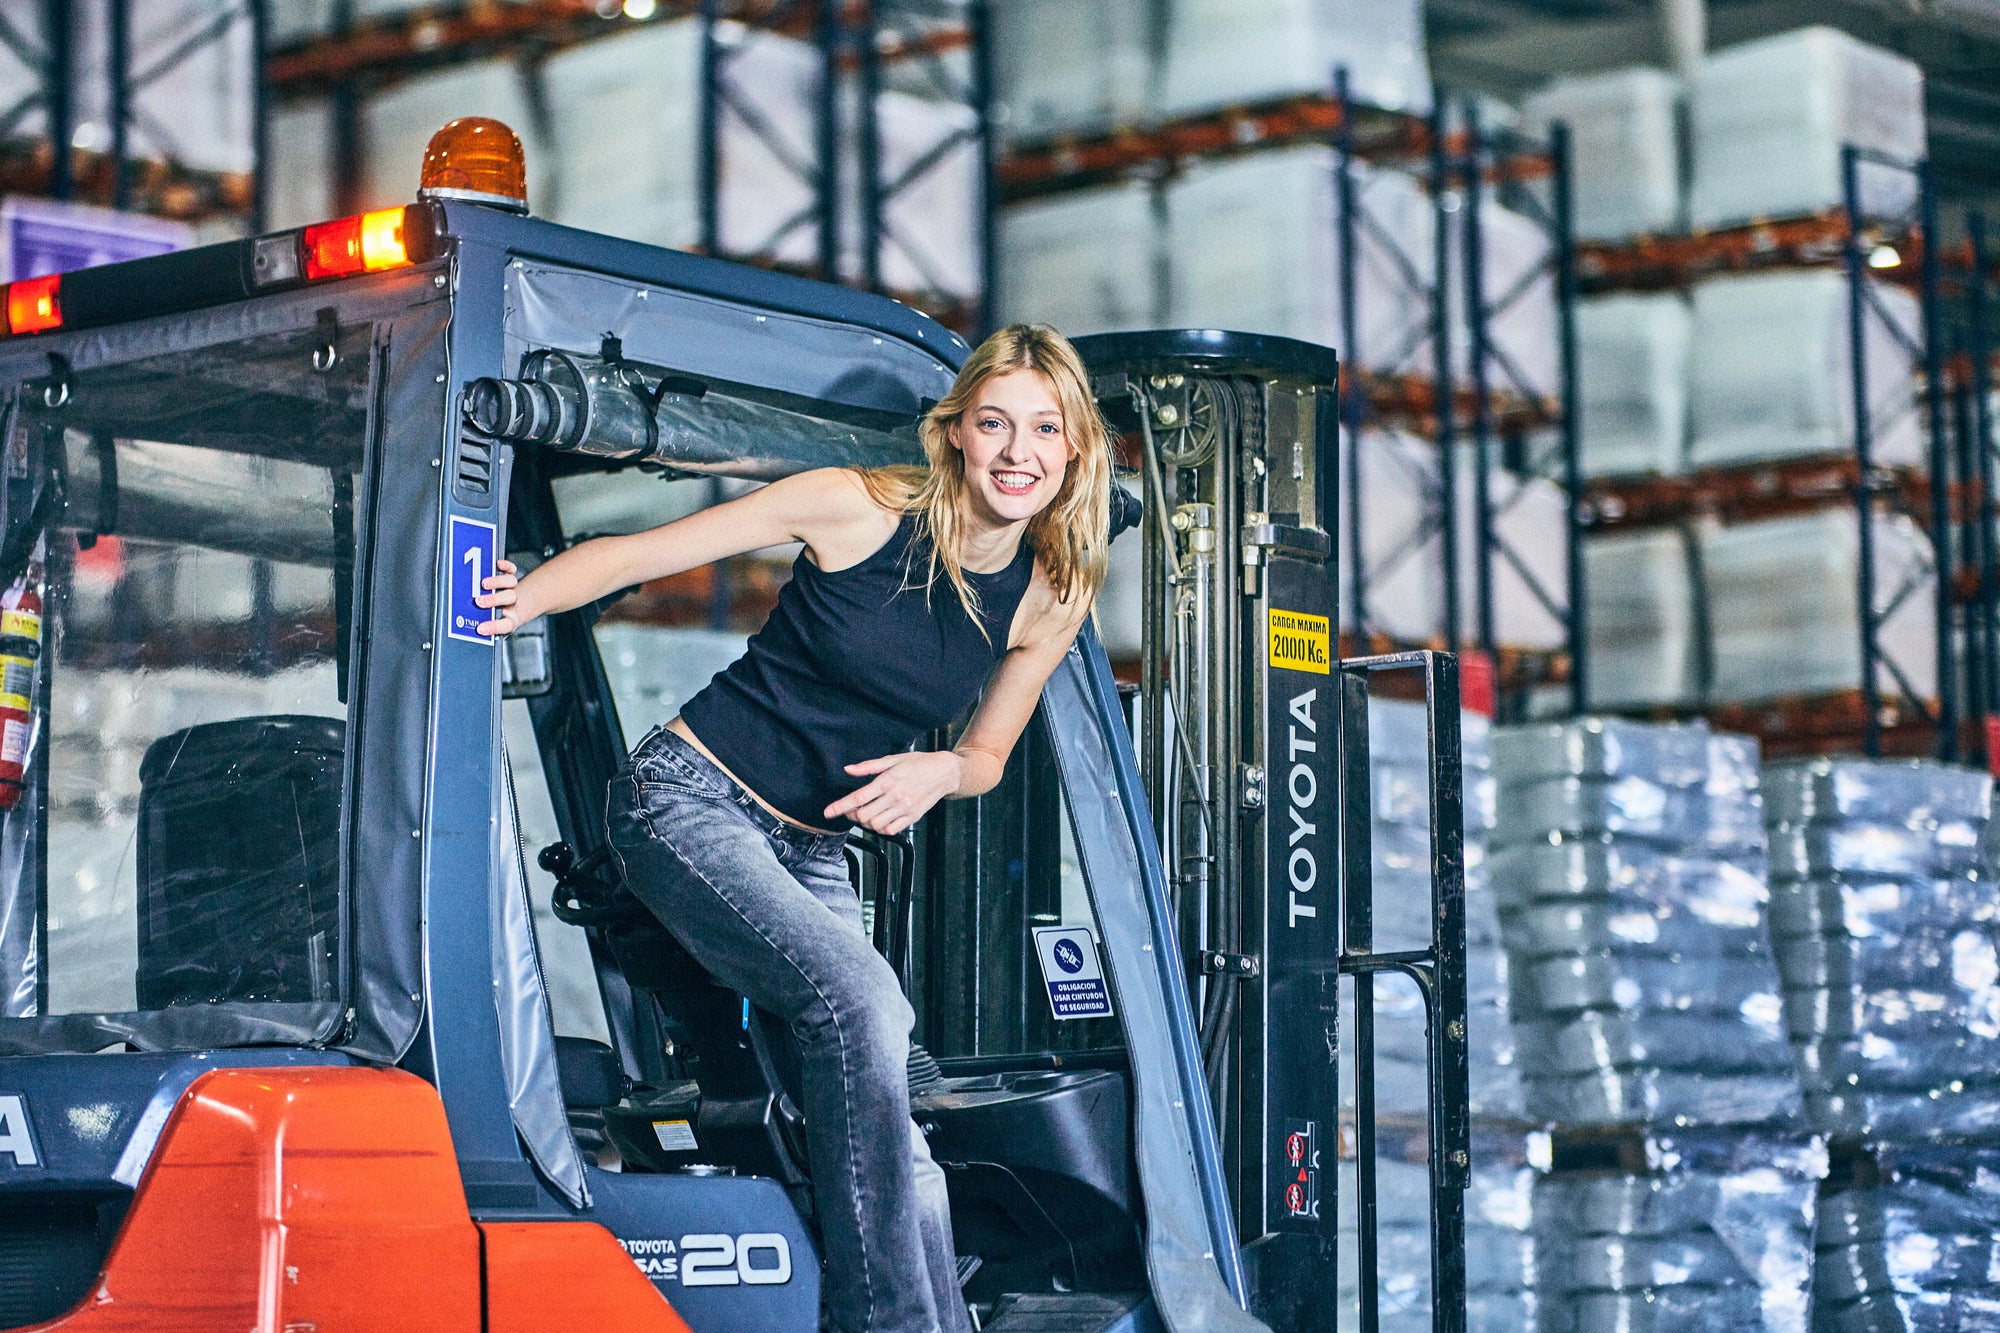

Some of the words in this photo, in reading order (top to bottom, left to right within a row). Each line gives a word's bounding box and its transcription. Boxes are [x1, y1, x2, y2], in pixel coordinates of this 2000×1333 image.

[463, 546, 482, 599] 1
[1272, 615, 1296, 630] CARGA
[1297, 618, 1327, 635] MAXIMA
[1273, 633, 1306, 661] 2000
[1288, 688, 1317, 928] TOYOTA
[1053, 993, 1071, 1002] USAR
[1071, 992, 1104, 1001] CINTURON
[1057, 982, 1097, 992] OBLIGACION
[1060, 1003, 1069, 1012] DE
[1069, 1002, 1105, 1012] SEGURIDAD
[627, 1239, 677, 1254] TOYOTA
[680, 1232, 792, 1286] 20
